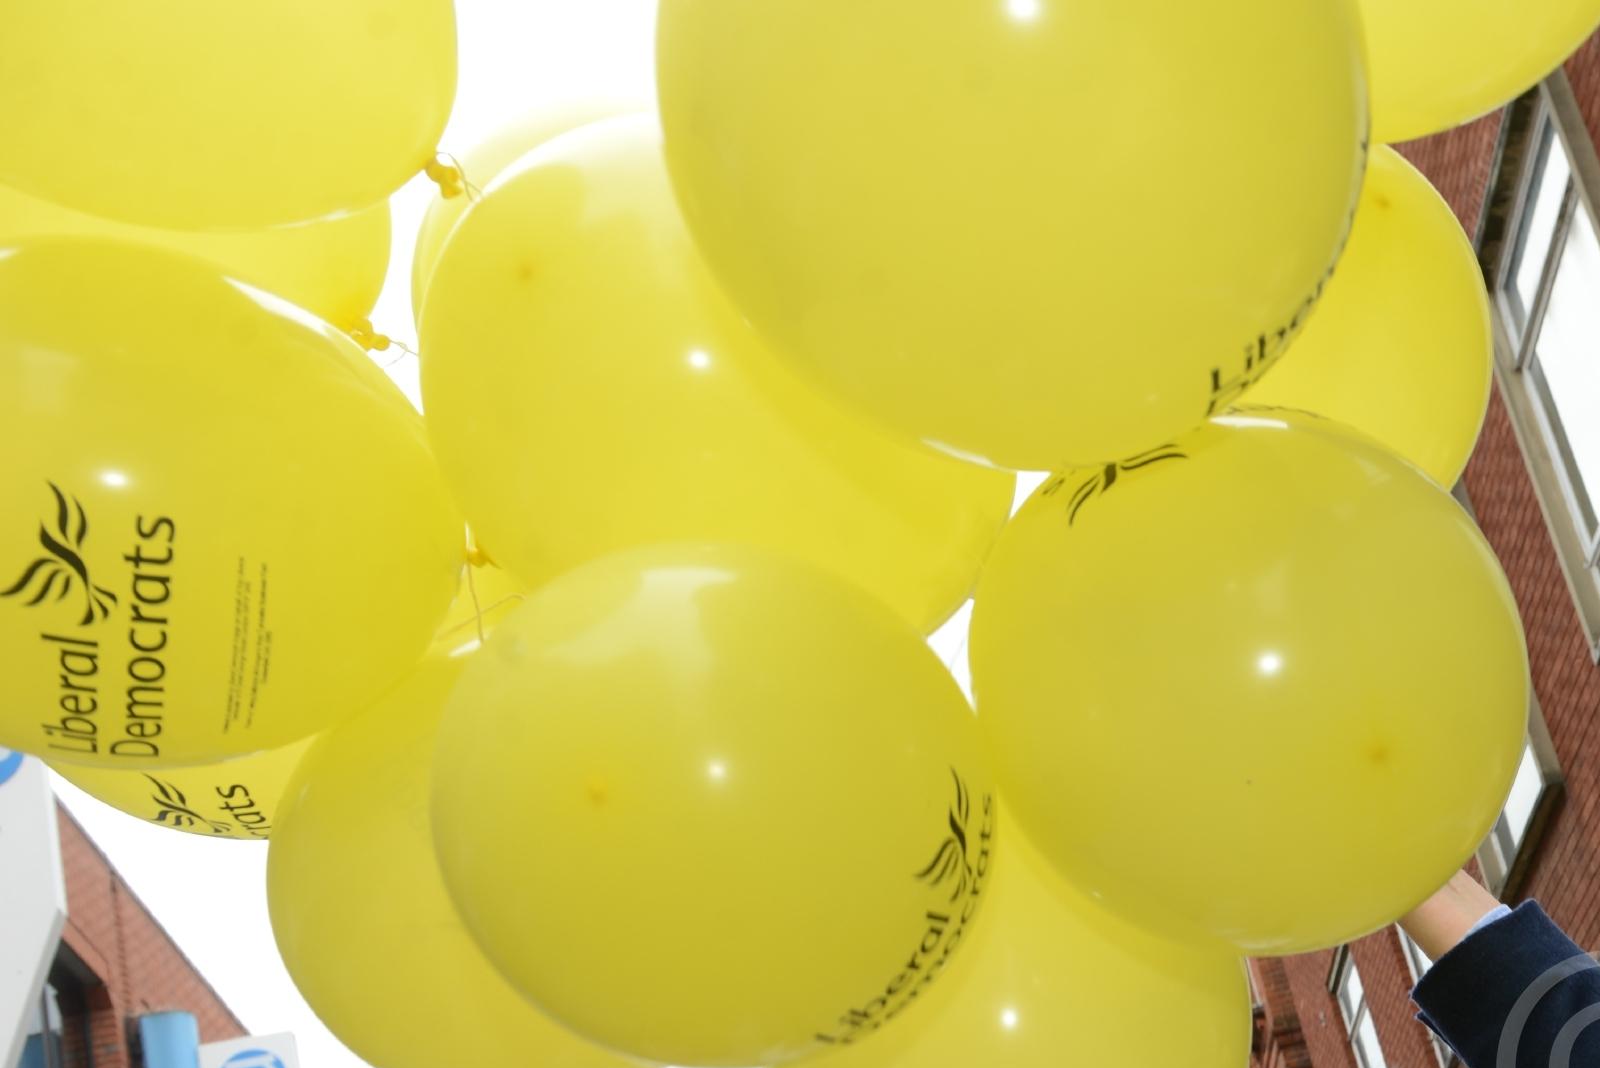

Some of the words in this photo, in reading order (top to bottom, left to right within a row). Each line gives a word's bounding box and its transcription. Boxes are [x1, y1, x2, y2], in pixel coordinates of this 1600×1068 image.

[40, 632, 99, 754] Liberal
[110, 515, 175, 757] Democrats
[814, 910, 950, 1044] Liberal
